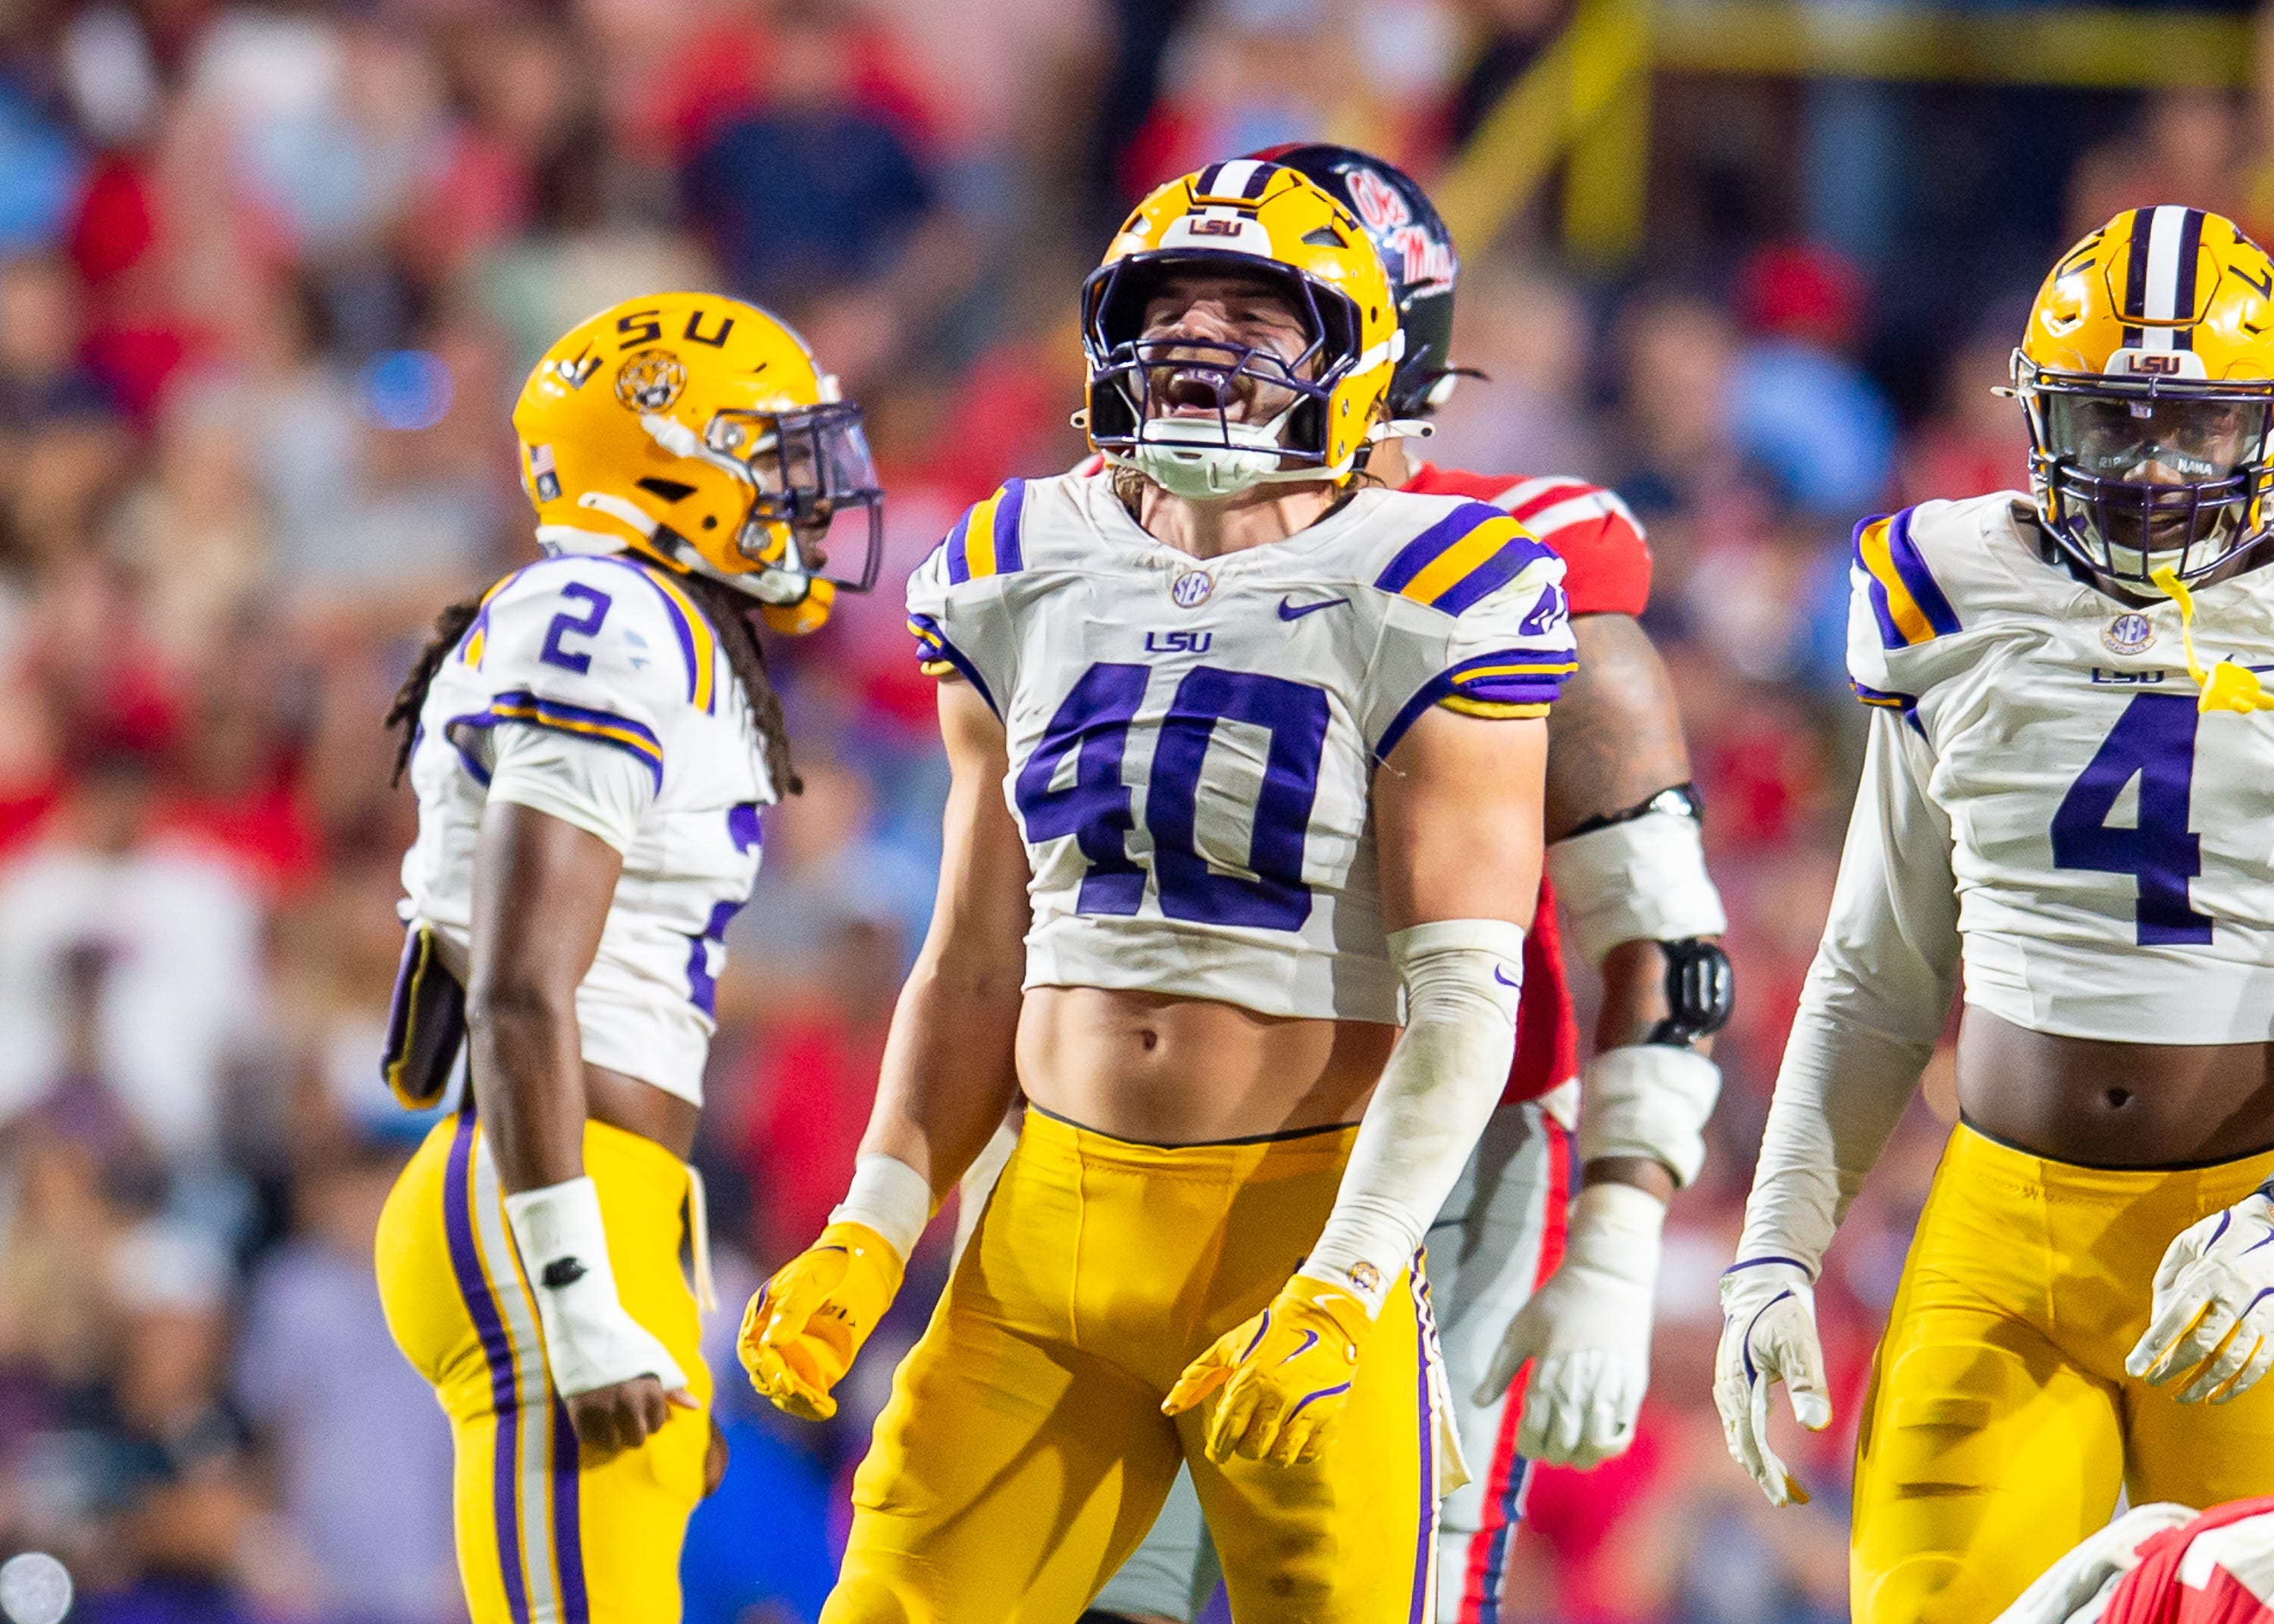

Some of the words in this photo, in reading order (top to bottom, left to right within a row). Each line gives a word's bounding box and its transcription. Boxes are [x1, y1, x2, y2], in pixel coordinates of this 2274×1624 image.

[1189, 219, 1242, 236] LSU
[2128, 355, 2180, 375] LSU
[2099, 457, 2123, 469] RIP
[1174, 572, 1210, 606] SEC
[540, 581, 612, 674] 2
[1145, 631, 1212, 653] LSU
[2113, 615, 2149, 644] SEC
[1014, 662, 1331, 932] 40
[2050, 692, 2213, 946] 4
